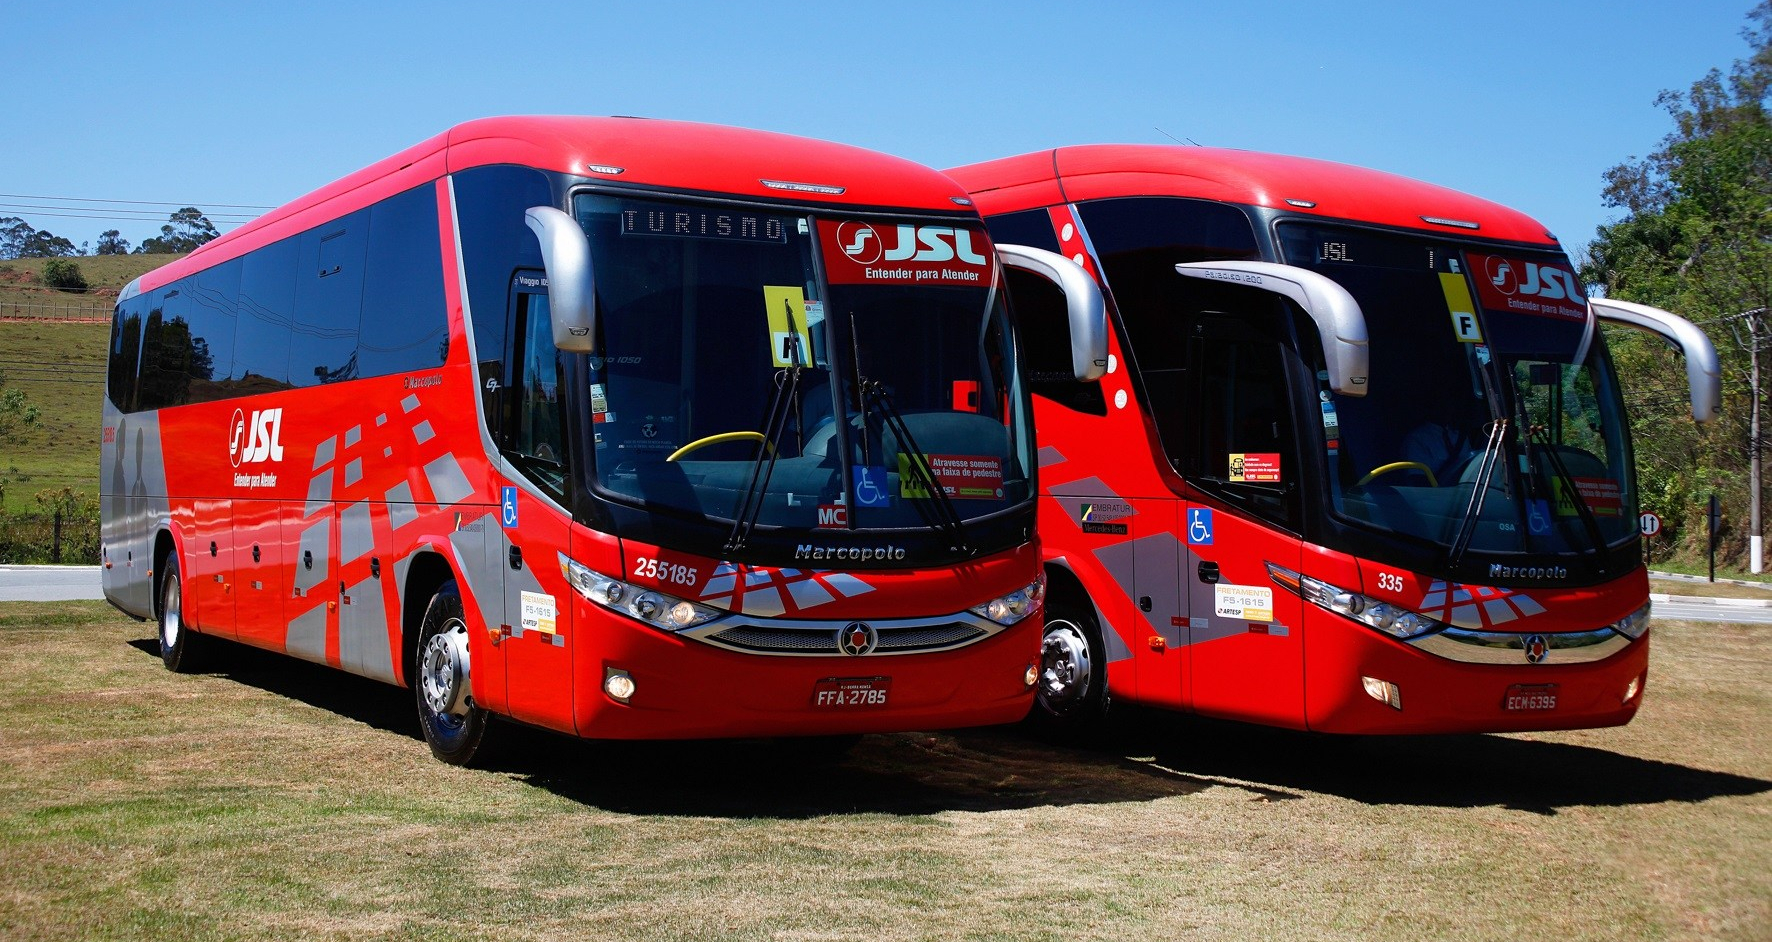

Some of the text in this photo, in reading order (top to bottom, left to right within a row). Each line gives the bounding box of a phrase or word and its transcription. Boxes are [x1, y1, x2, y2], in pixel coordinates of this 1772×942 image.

[624, 210, 781, 239] TURISMO
[885, 224, 987, 266] JSL
[1320, 242, 1353, 262] JSL
[519, 276, 549, 287] Viaggio 105
[865, 267, 979, 281] Entender para Atender
[1519, 262, 1586, 306] JSL
[1507, 297, 1584, 319] Entender para Atender
[1460, 316, 1472, 335] F
[409, 373, 442, 389] Marcopolo
[242, 408, 284, 463] JSL
[933, 458, 999, 469] Atravesse somente
[942, 467, 960, 477] faixa
[962, 467, 971, 477] de
[972, 468, 1002, 479] pedestre
[818, 508, 846, 525] MC
[1093, 503, 1131, 513] EMBRATUR
[795, 544, 906, 561] Marcopolo
[634, 557, 698, 586] 255185
[1489, 563, 1567, 579] Marcopolo
[1378, 572, 1403, 592] 335
[1216, 587, 1271, 597] FRETAMENTO
